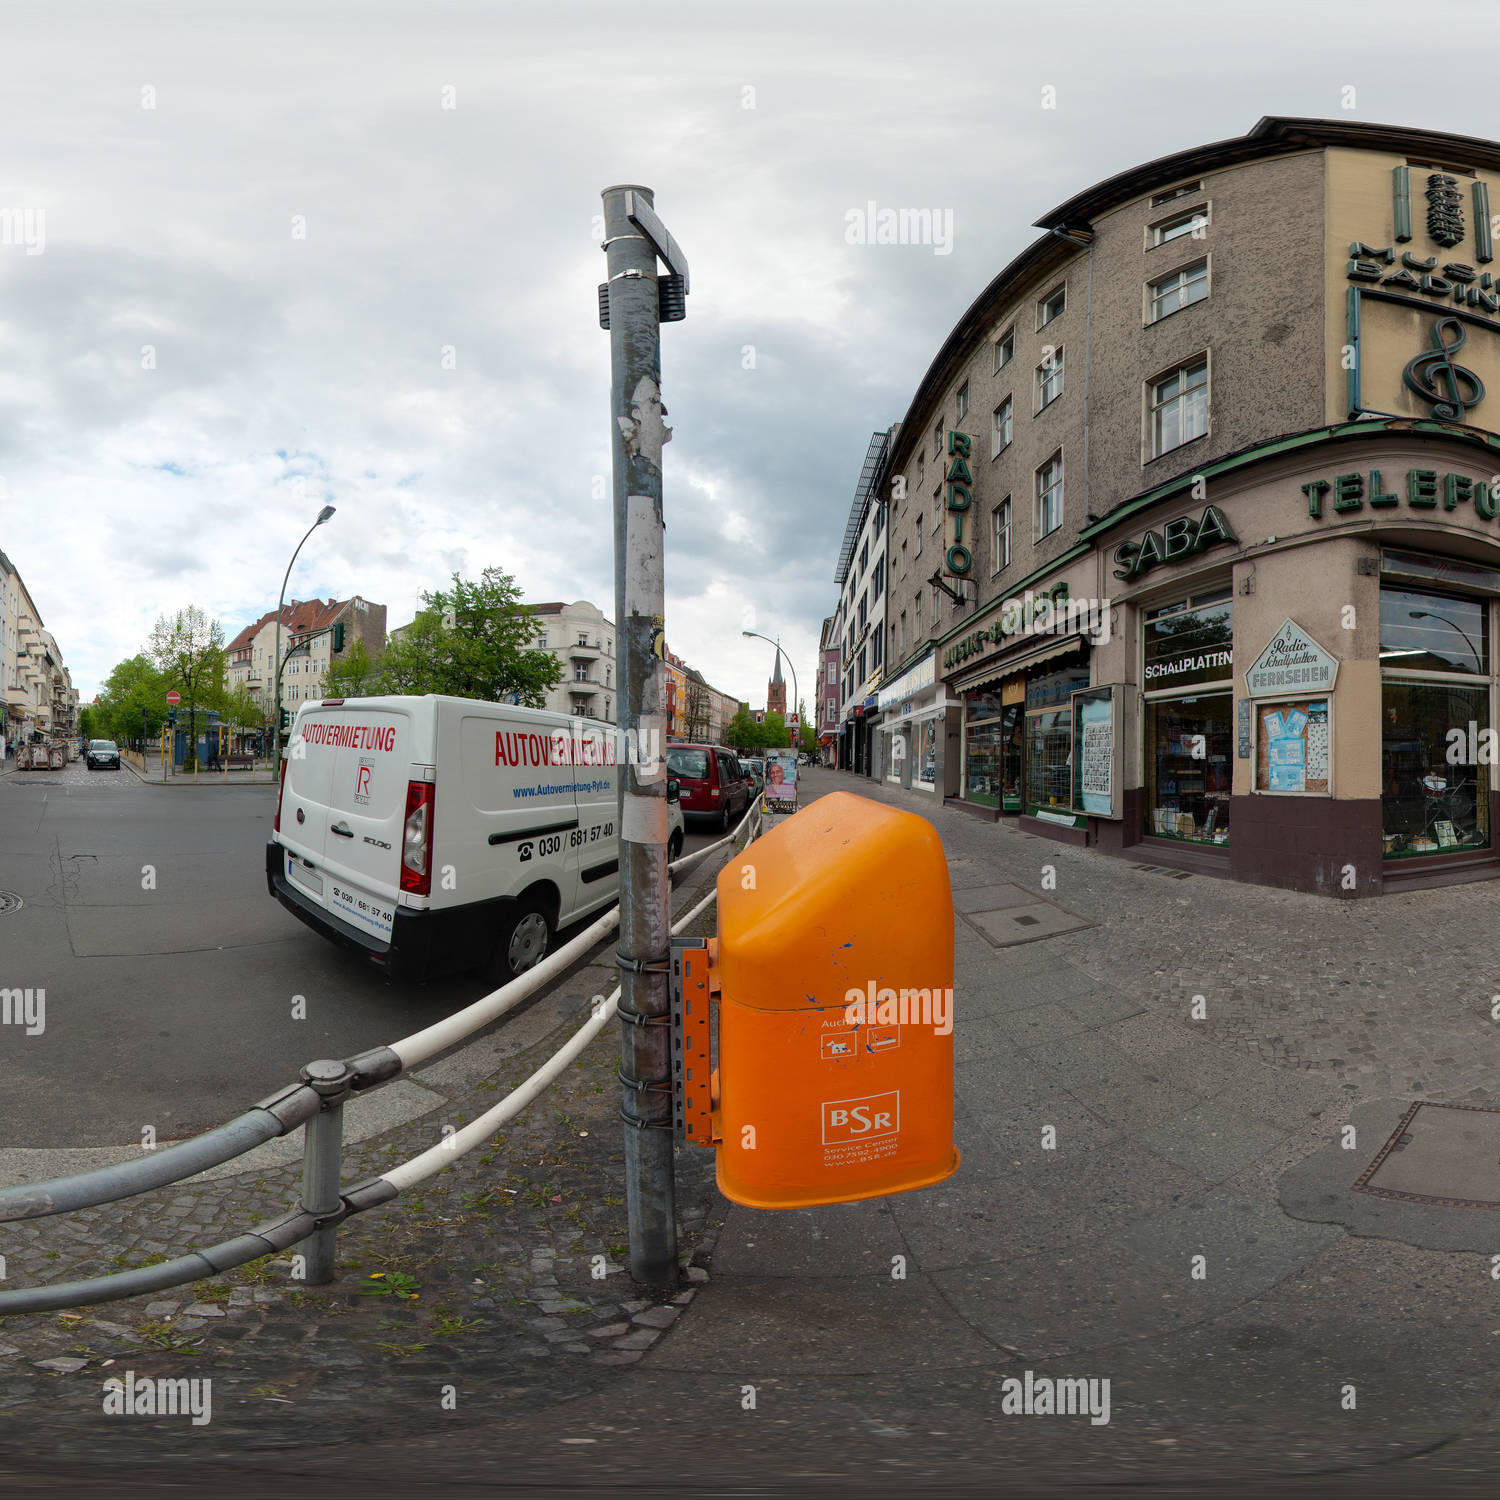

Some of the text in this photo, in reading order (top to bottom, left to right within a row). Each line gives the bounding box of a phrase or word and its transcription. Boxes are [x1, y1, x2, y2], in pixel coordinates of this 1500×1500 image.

[946, 430, 973, 574] RADIO
[1113, 505, 1238, 581] SABA
[1260, 652, 1318, 669] Schallplatten
[1253, 666, 1329, 687] FERNSEHEN
[301, 723, 396, 753] AUTOVERMIETUNG
[495, 731, 616, 767] AUTOVERMIETUNG
[513, 780, 611, 799] www.Autovermietung-Ryll.de
[539, 835, 561, 857] 030
[570, 831, 587, 848] 681
[590, 826, 601, 842] 57
[603, 823, 614, 838] 40
[341, 892, 353, 904] 030
[371, 907, 381, 917] 57
[382, 912, 393, 922] 40
[831, 1105, 892, 1133] BSR
[824, 1137, 898, 1155] Service Center
[824, 1154, 845, 1162] 030
